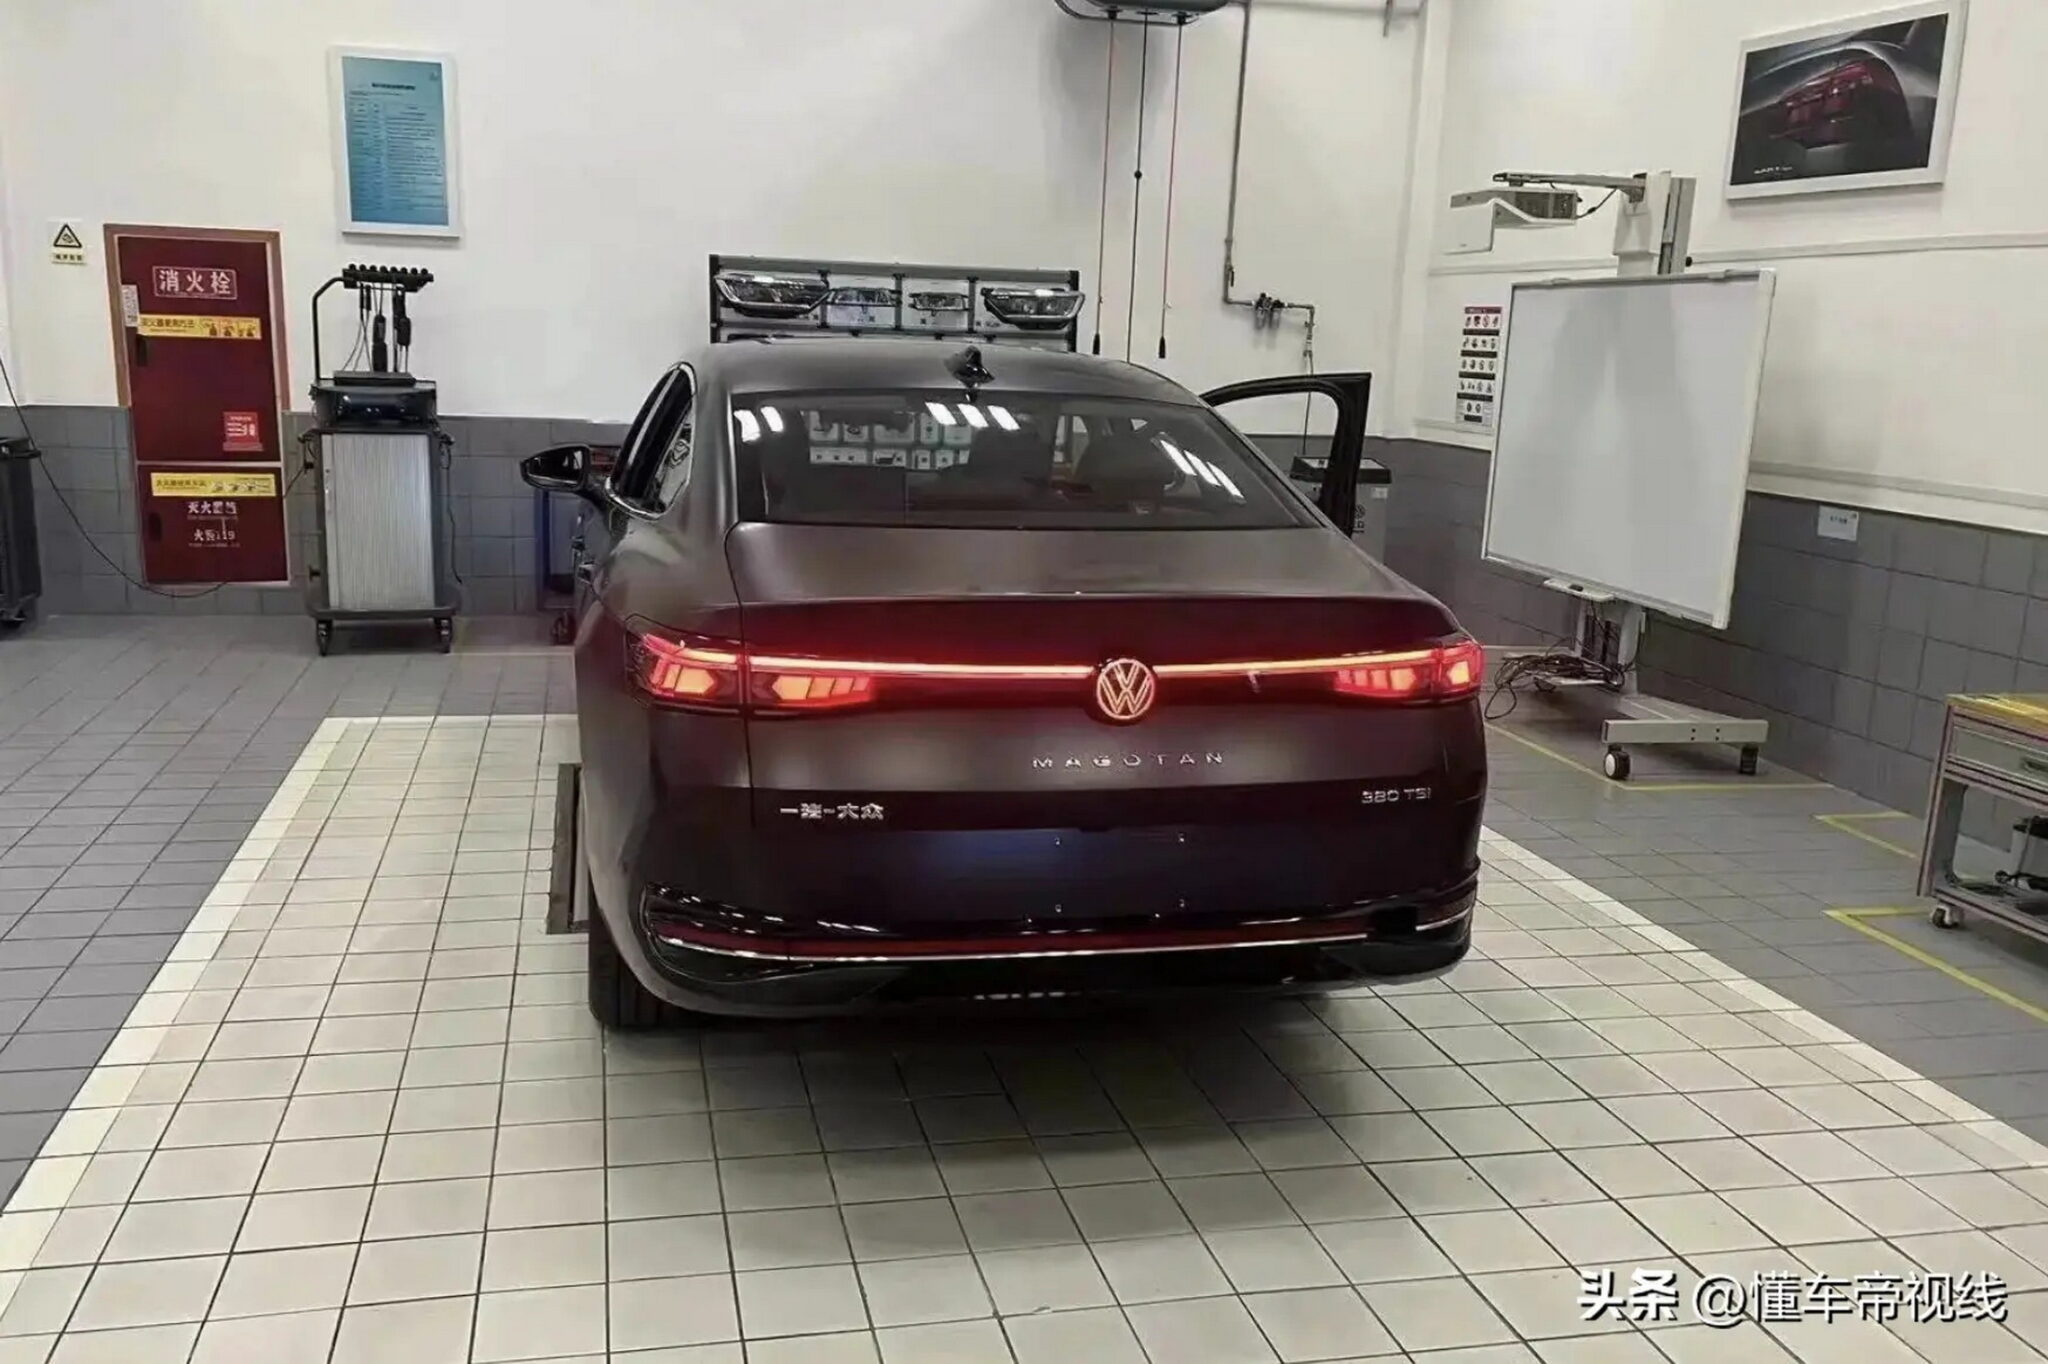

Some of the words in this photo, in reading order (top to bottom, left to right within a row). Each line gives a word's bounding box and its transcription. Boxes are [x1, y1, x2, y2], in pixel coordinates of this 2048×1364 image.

[159, 269, 231, 295] 消火栓
[1033, 752, 1223, 769] MAGOTAN
[1361, 789, 1400, 804] 380
